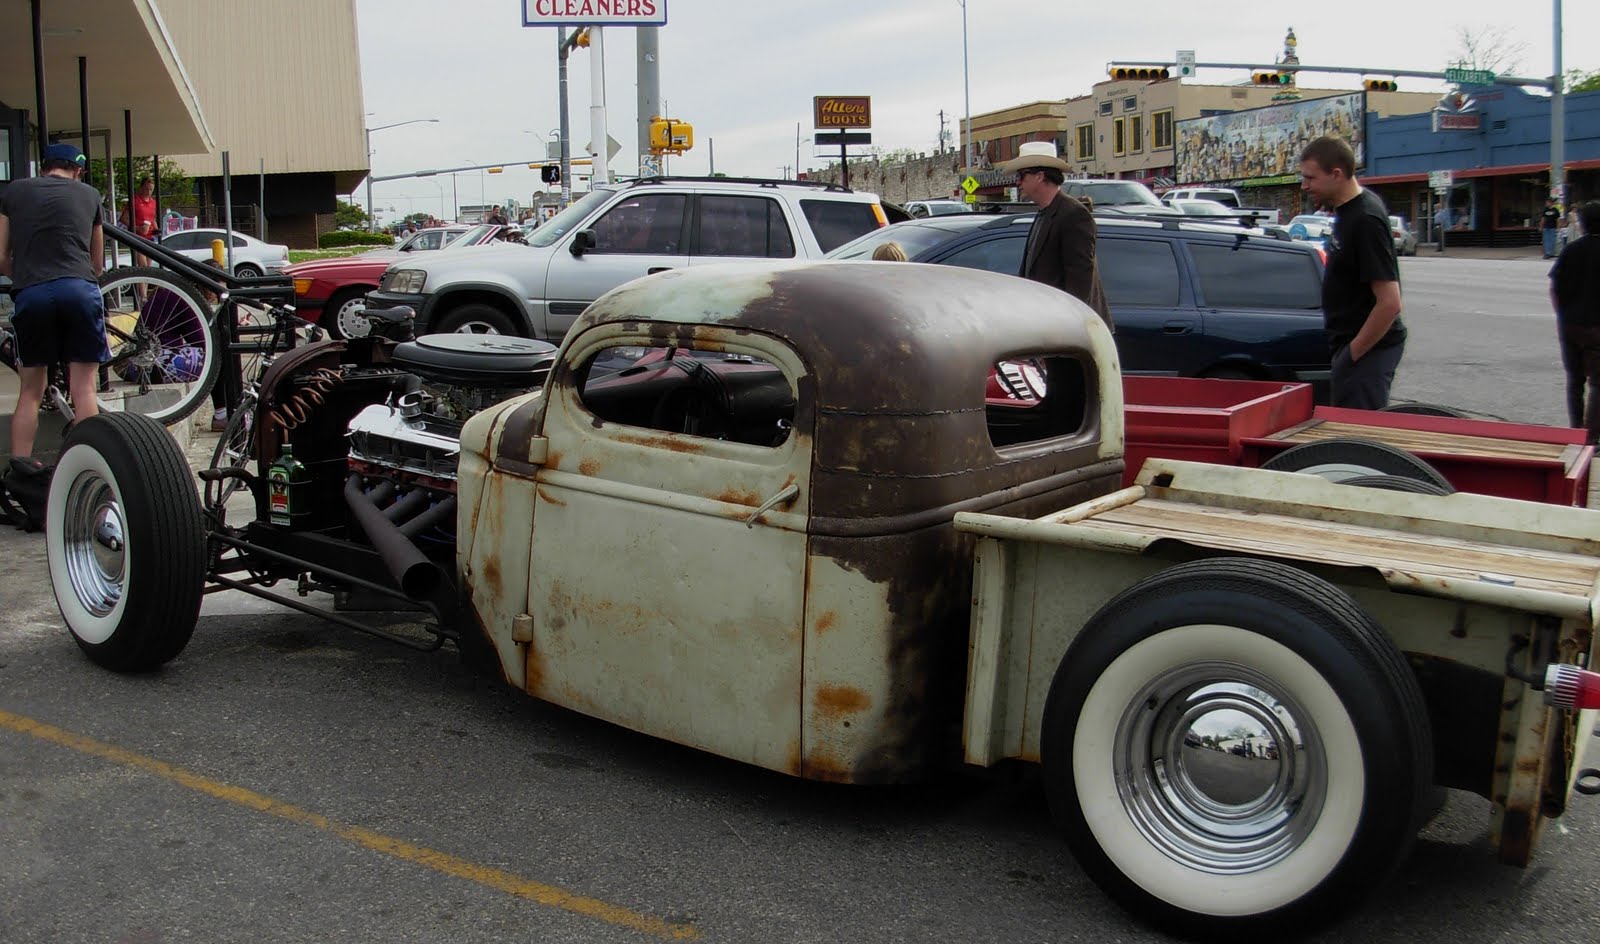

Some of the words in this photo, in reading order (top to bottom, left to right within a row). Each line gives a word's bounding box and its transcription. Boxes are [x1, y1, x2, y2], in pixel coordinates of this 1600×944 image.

[535, 0, 656, 16] CLEANERS
[1449, 70, 1487, 84] ELIZABETH
[822, 115, 866, 124] BOOTS
